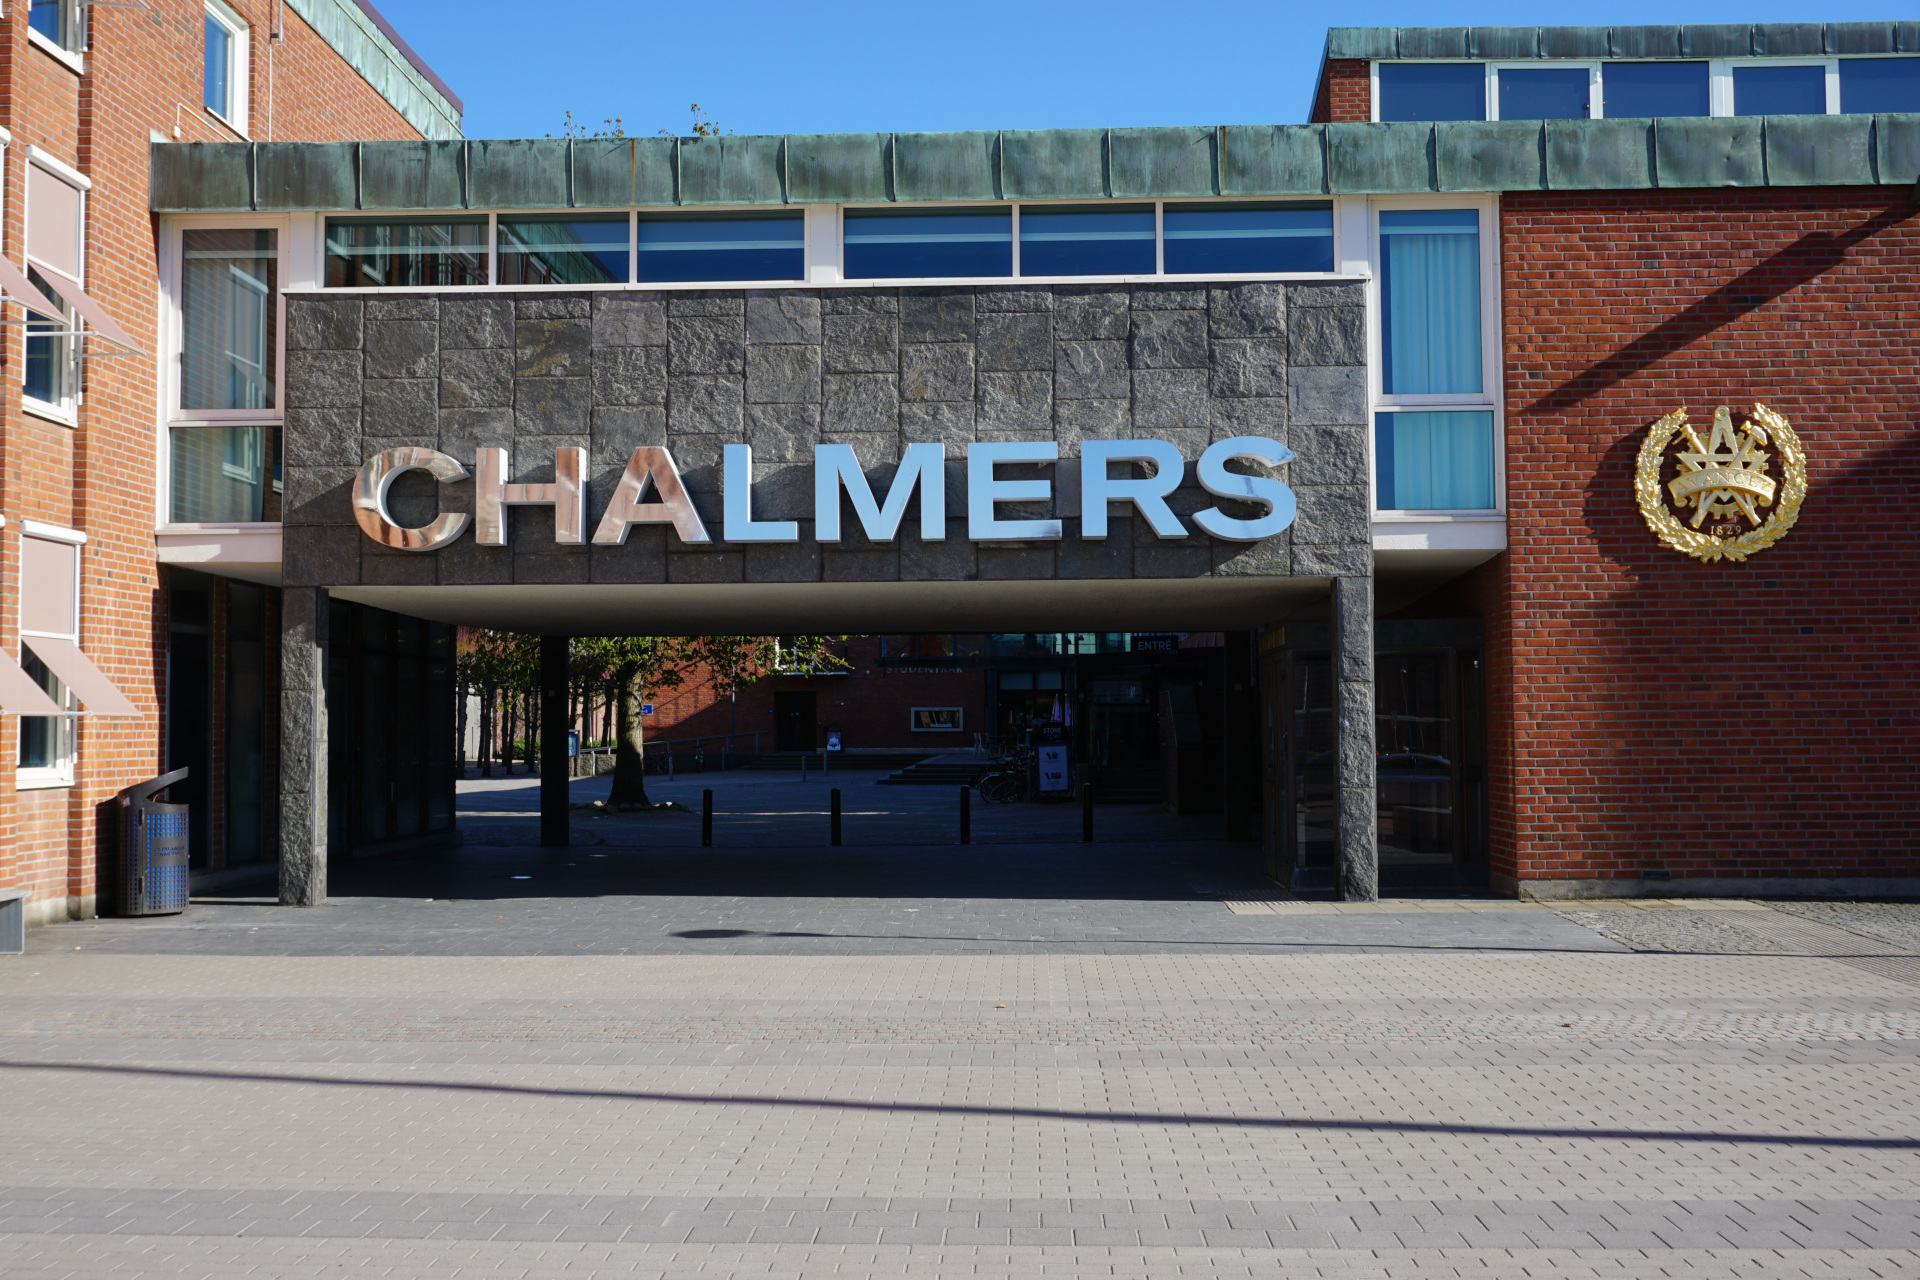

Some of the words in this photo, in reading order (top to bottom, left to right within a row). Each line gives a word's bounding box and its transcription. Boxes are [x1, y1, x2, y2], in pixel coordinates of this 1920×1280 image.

[1677, 471, 1772, 492] AVANCEZ
[352, 436, 1297, 552] CHALMERS
[1710, 525, 1742, 535] 1829
[1137, 638, 1172, 651] ENTRÉ
